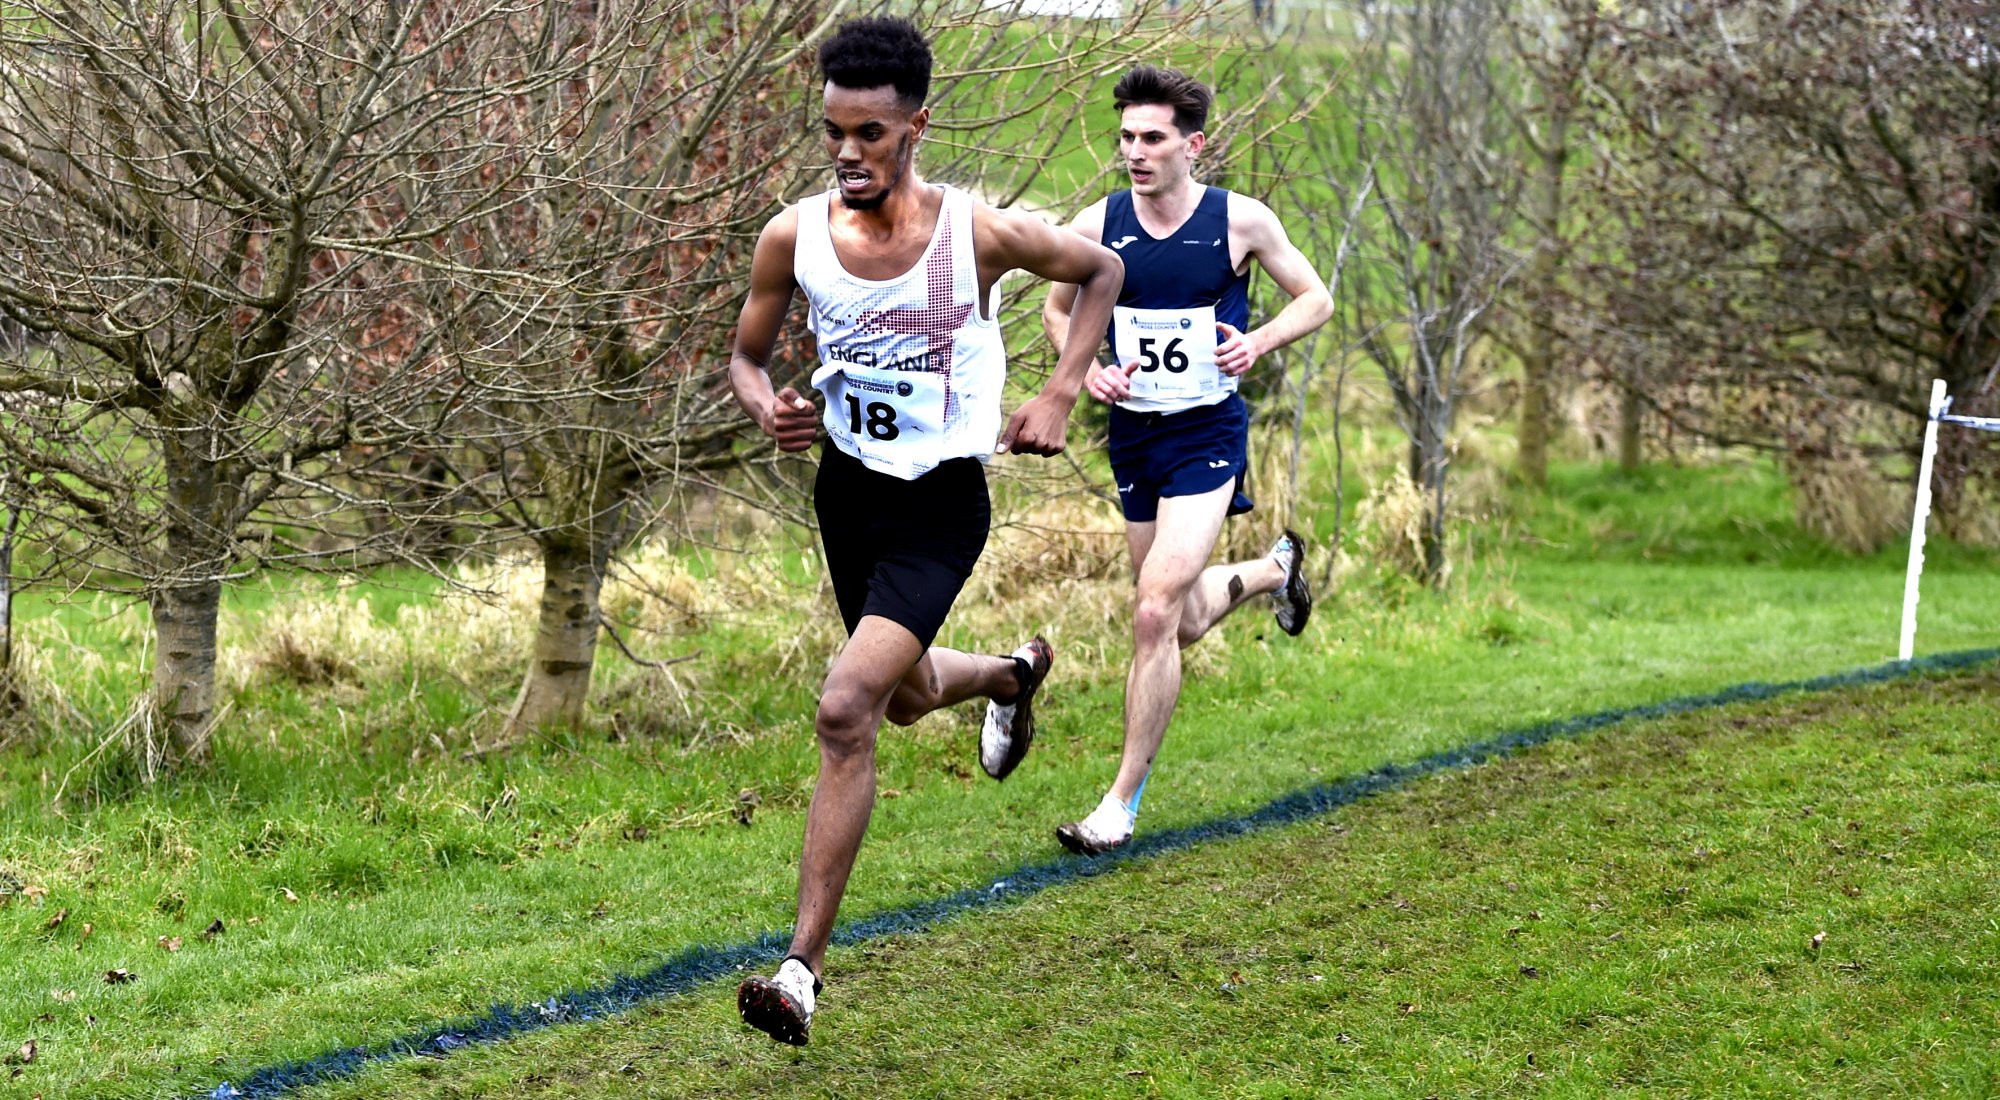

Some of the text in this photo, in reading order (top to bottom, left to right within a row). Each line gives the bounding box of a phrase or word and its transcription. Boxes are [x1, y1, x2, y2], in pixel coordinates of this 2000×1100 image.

[829, 344, 944, 373] ENGLAND
[1139, 337, 1189, 374] 56
[845, 371, 871, 382] ORTHERN
[862, 385, 895, 395] COUNTRY
[845, 392, 899, 441] 18
